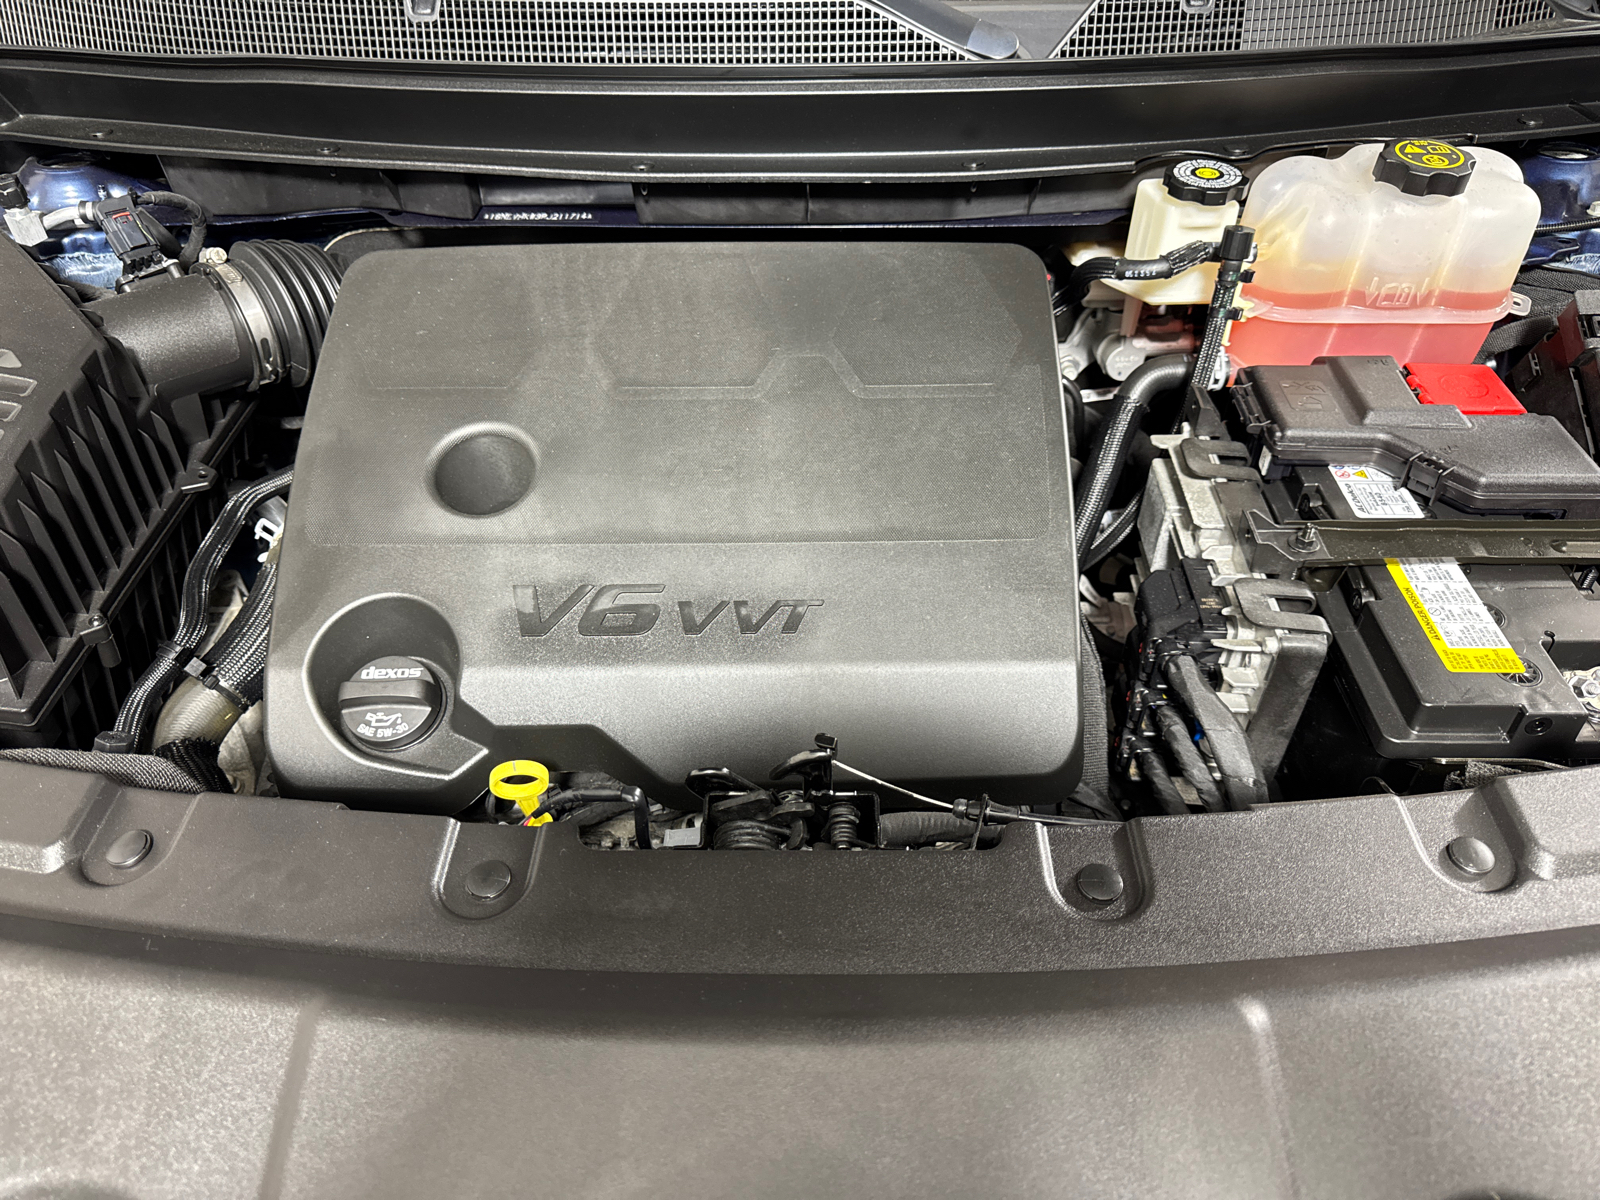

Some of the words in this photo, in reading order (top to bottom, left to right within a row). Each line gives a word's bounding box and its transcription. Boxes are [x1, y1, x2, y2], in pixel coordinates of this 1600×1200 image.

[1403, 587, 1422, 609] POISON
[513, 584, 666, 636] V6
[677, 599, 825, 635] VVT
[1417, 608, 1436, 637] DANGER
[361, 666, 424, 680] dexos
[357, 723, 377, 737] SAE
[376, 722, 409, 738] 5W-30
